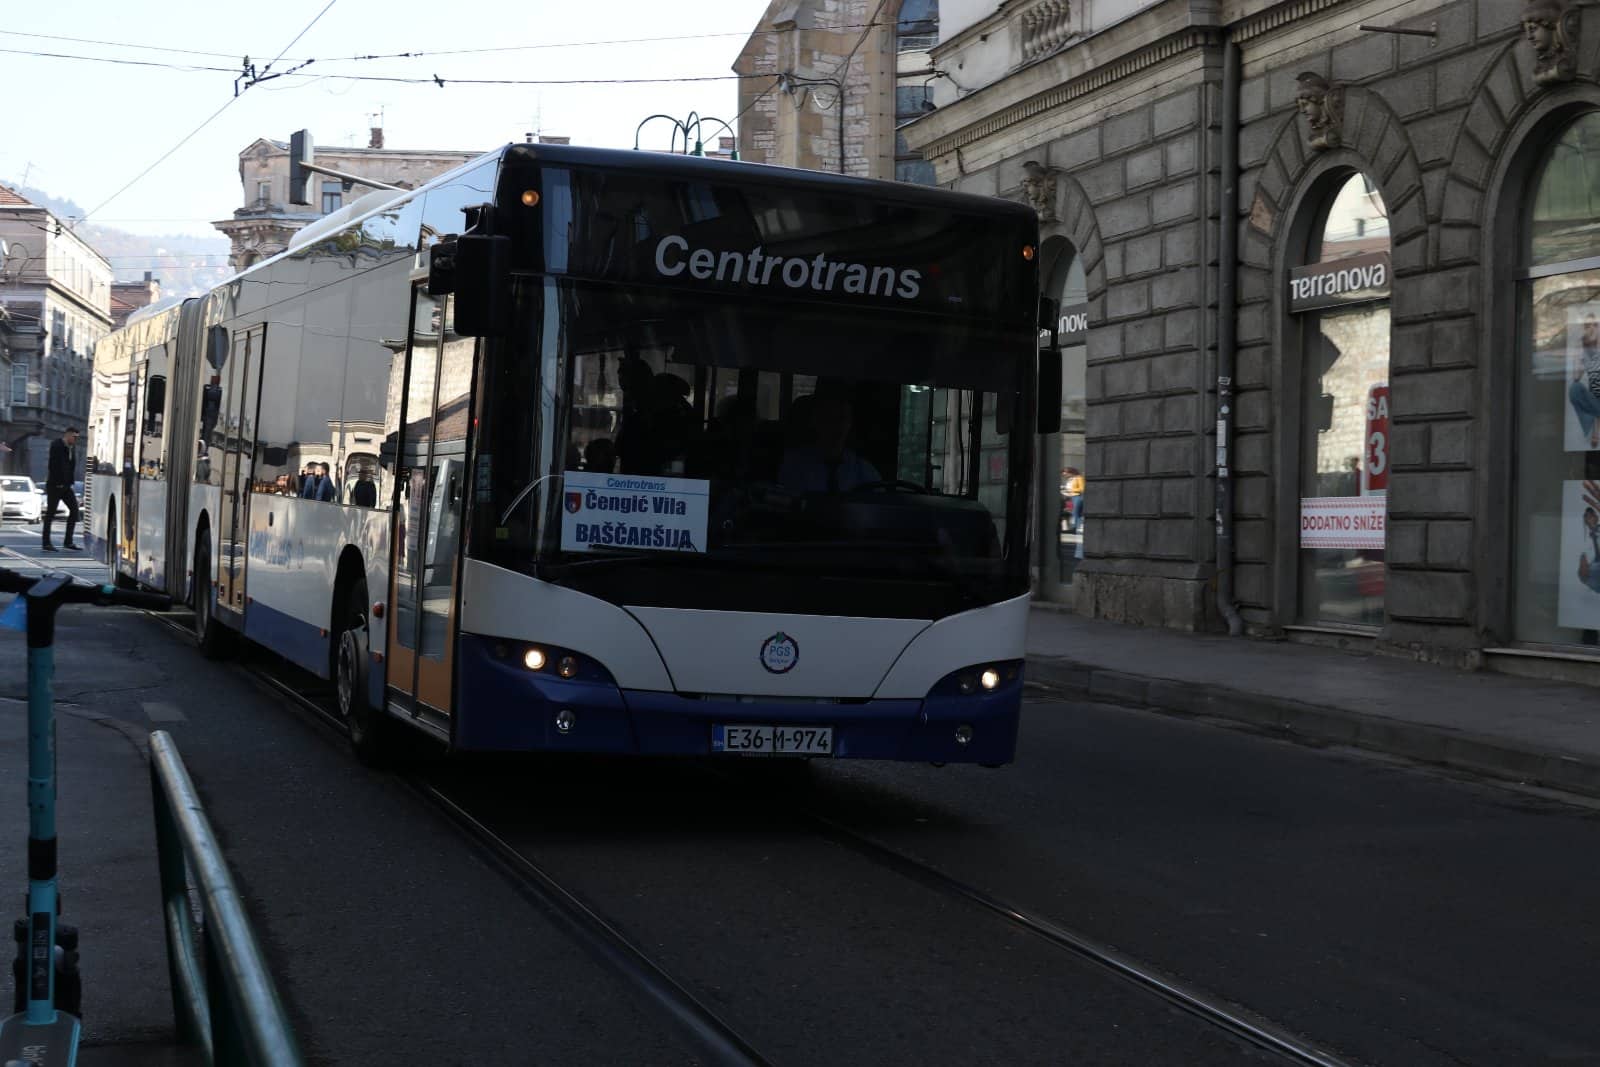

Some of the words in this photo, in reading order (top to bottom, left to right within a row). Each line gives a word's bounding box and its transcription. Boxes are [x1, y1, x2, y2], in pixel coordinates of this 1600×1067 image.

[655, 234, 922, 299] Centrotrans
[1290, 263, 1385, 300] Terranova
[607, 477, 666, 491] Centrotrans
[585, 489, 649, 513] Čengić
[652, 496, 686, 515] Vila
[575, 521, 691, 549] BAŠČARŠIJA
[1302, 515, 1350, 531] DODATNO
[727, 729, 829, 750] E36-M-974
